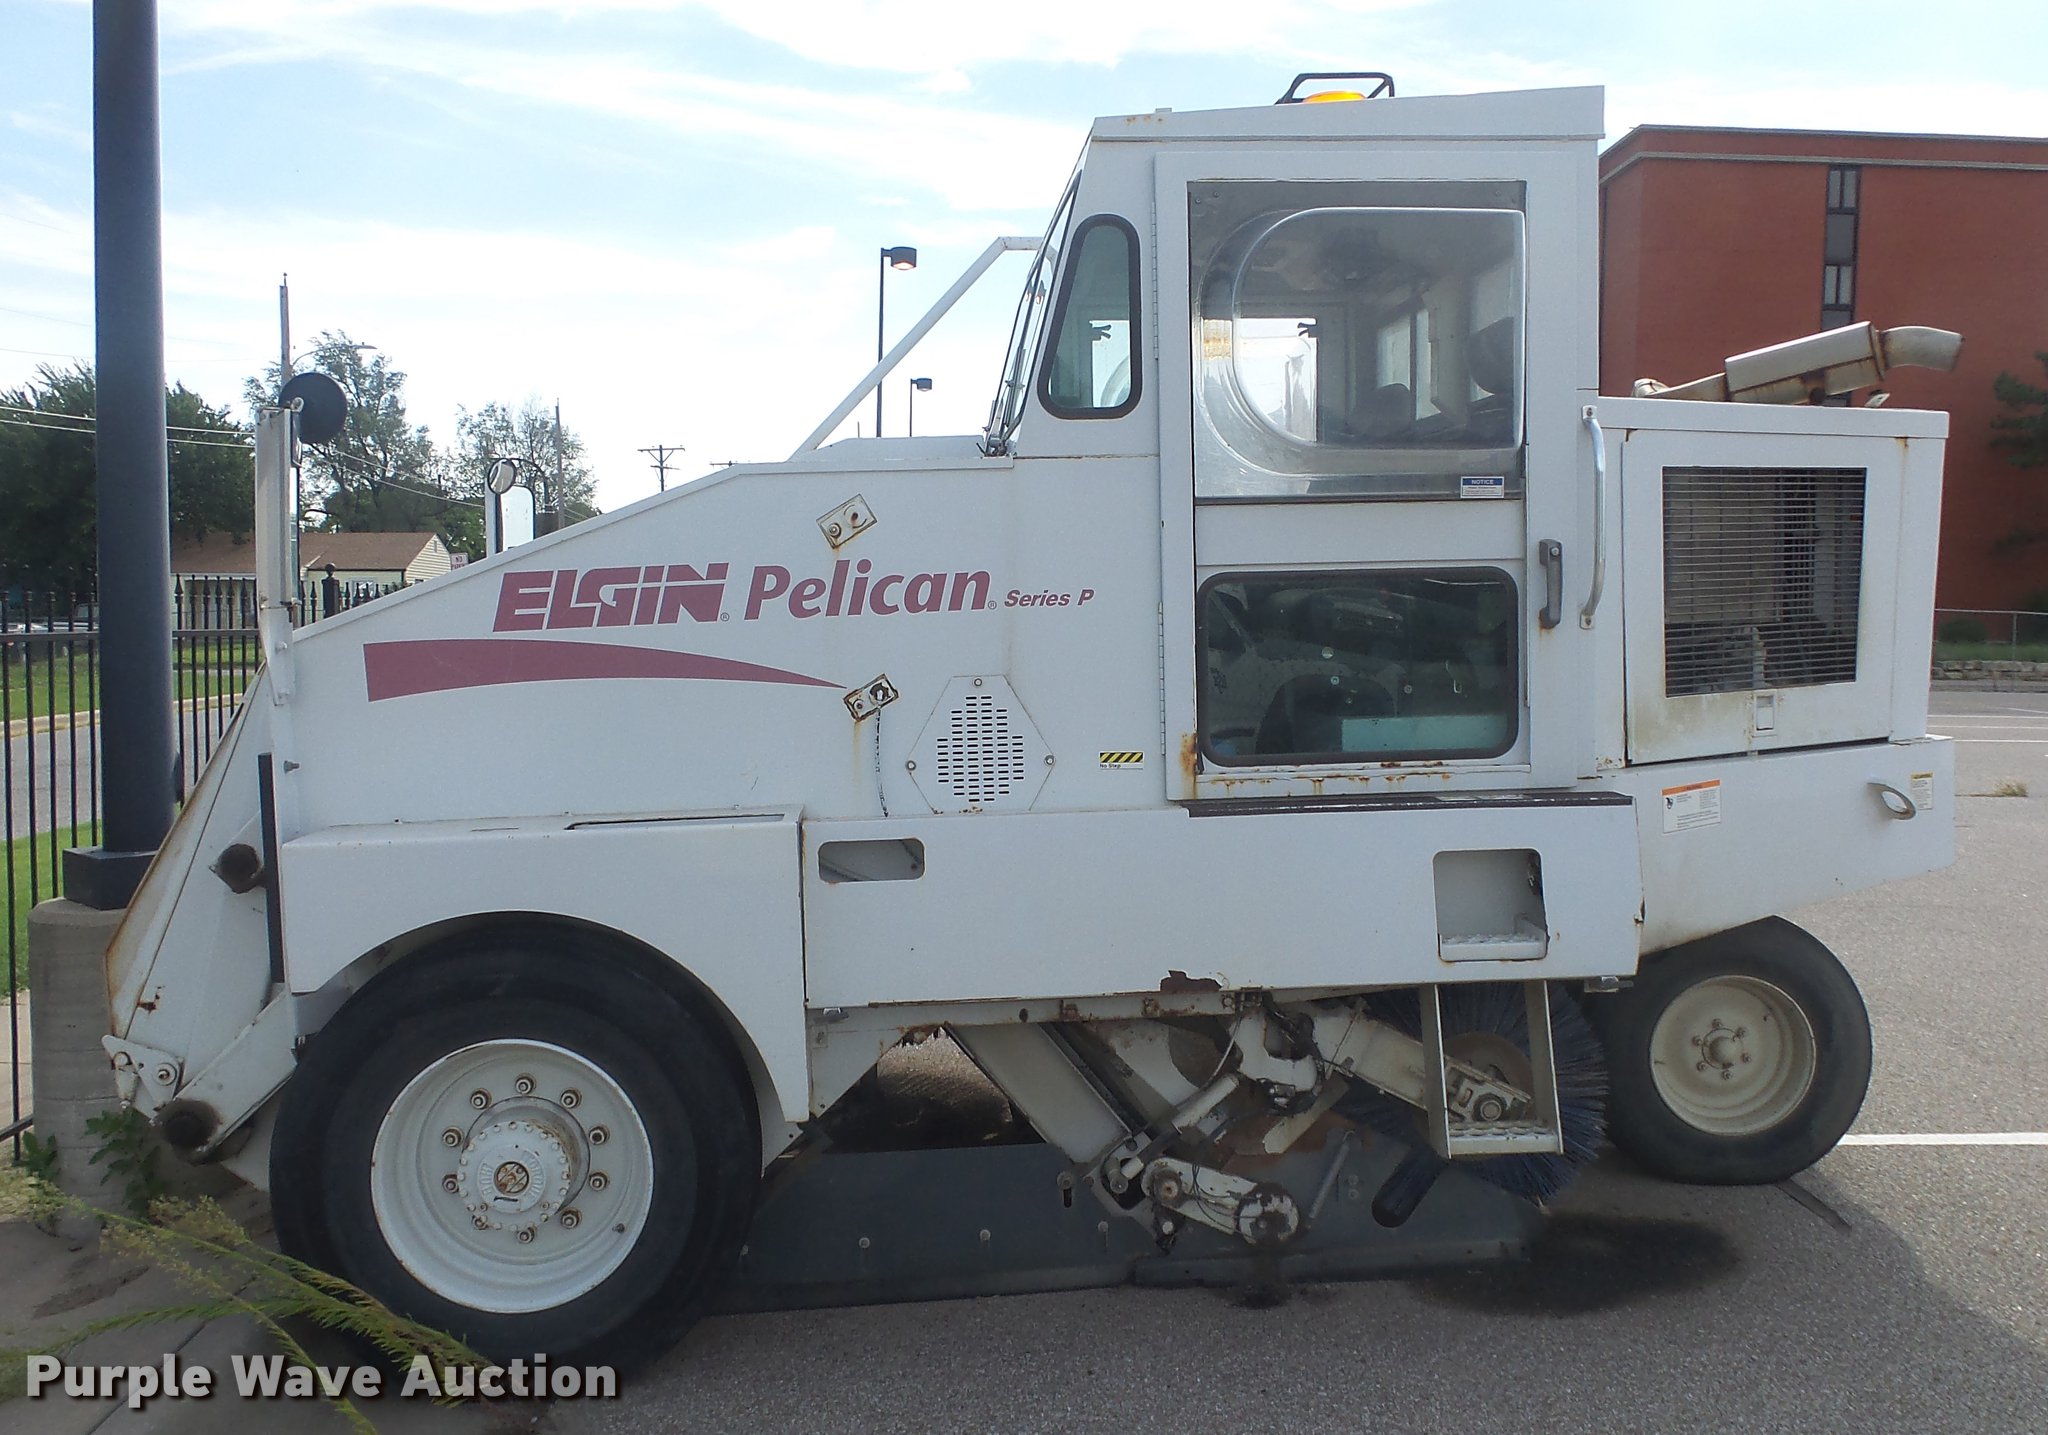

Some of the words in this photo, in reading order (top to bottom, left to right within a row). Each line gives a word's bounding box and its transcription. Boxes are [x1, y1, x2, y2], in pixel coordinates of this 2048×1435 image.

[493, 562, 729, 632] ELGIN
[743, 558, 991, 620] Pelican
[1004, 589, 1071, 608] Series
[1077, 588, 1095, 606] P
